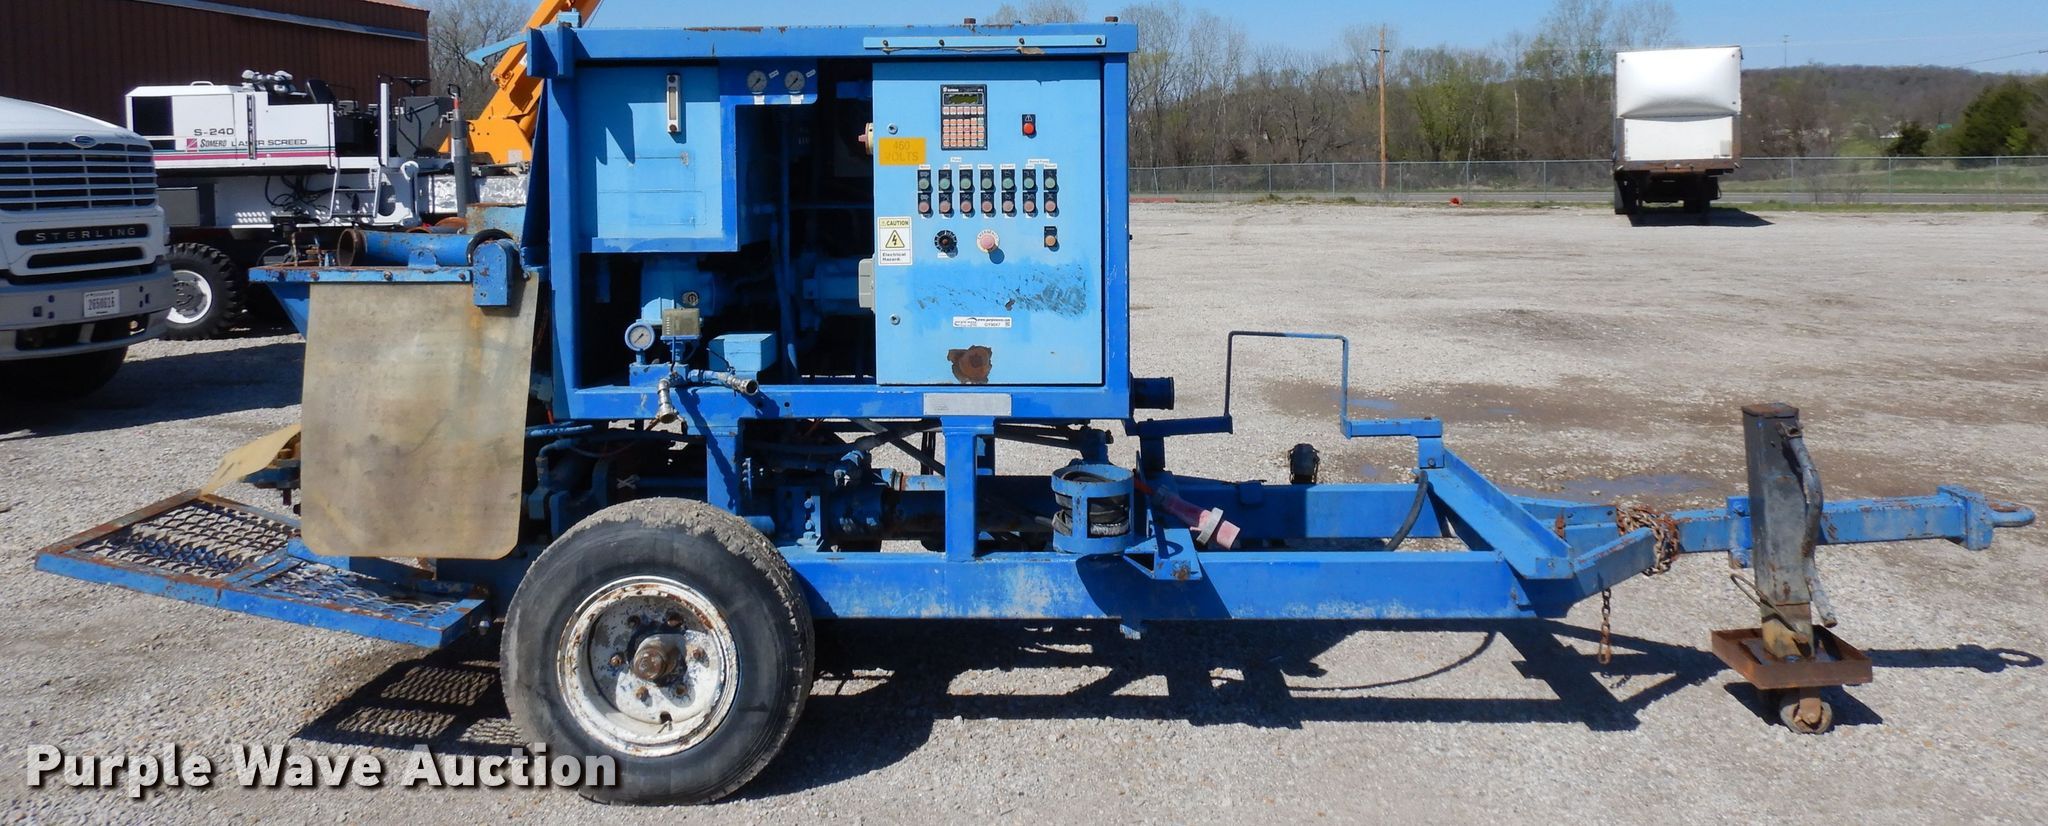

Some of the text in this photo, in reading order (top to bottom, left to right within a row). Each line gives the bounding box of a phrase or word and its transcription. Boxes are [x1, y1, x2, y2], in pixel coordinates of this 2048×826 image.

[194, 127, 234, 136] S-240
[231, 139, 265, 147] LAR
[267, 138, 308, 146] SCREED
[36, 227, 136, 242] STERLING
